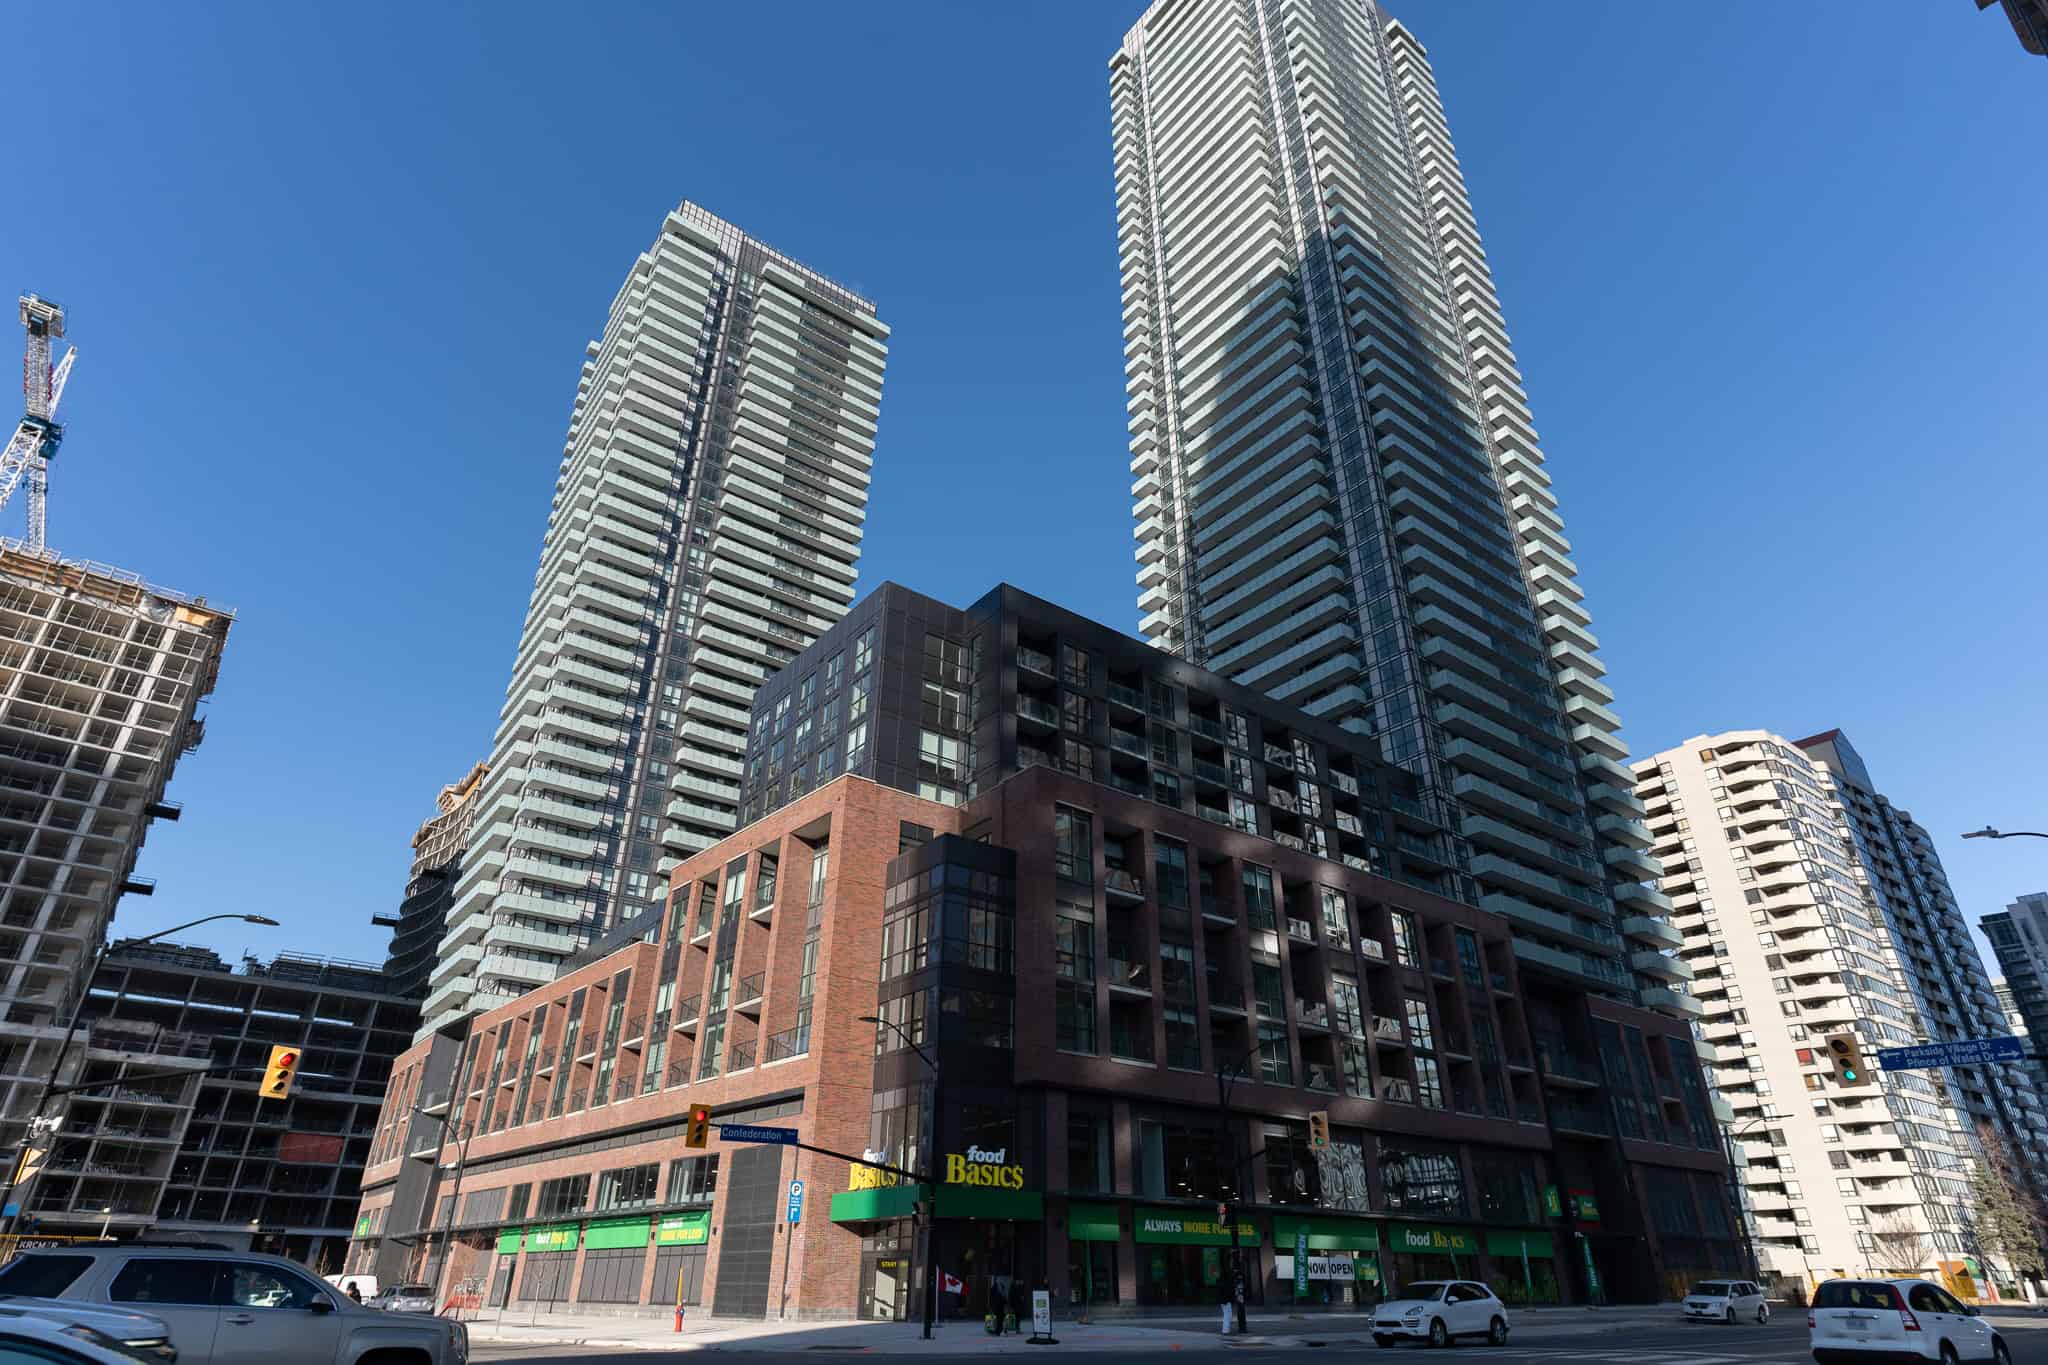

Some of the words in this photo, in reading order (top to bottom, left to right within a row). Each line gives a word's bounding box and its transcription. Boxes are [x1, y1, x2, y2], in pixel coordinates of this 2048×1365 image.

[1903, 1047, 1944, 1058] Parkside
[1945, 1043, 1978, 1056] Village
[1979, 1041, 1991, 1050] Dr
[1907, 1057, 1938, 1066] Prince
[1940, 1056, 1949, 1064] of
[1952, 1052, 1980, 1063] Wales
[1983, 1051, 1995, 1061] Dr
[722, 1127, 782, 1140] Confederation
[968, 1145, 1005, 1163] food
[1144, 1219, 1182, 1233] ALWAYS
[1406, 1229, 1430, 1246] food
[1331, 1263, 1354, 1274] OPEN
